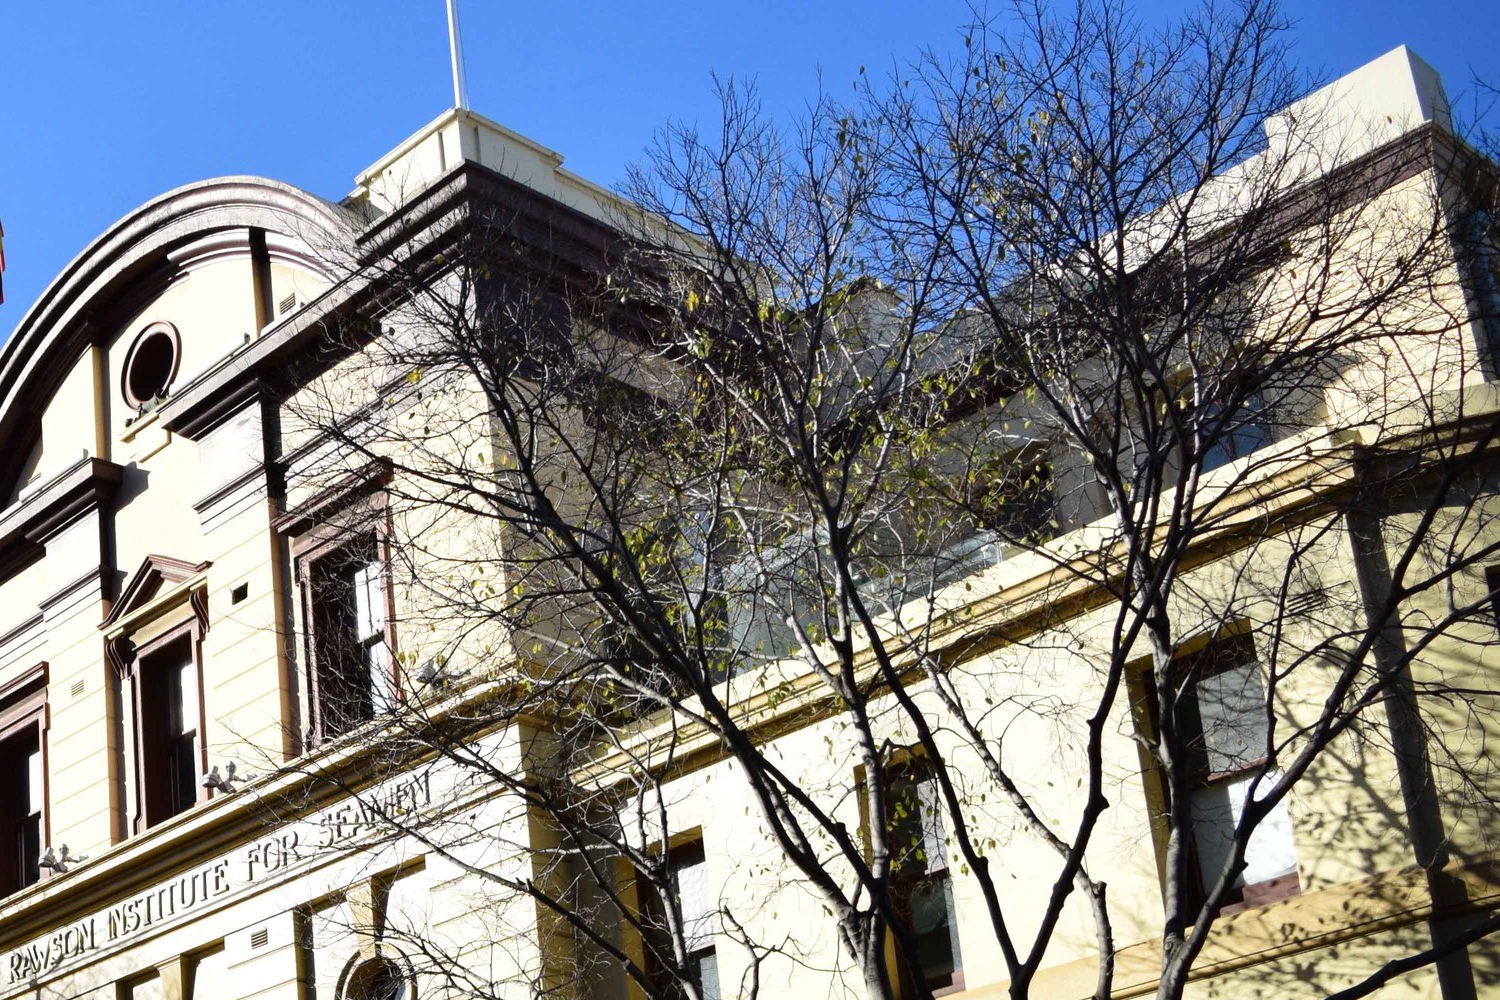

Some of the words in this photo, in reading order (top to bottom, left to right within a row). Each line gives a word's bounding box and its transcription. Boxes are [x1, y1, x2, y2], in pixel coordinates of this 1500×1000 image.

[9, 918, 97, 985] RAWSON
[107, 858, 230, 942] INSTITUTE
[247, 830, 301, 882] FOR
[318, 769, 431, 848] SEAMEN
